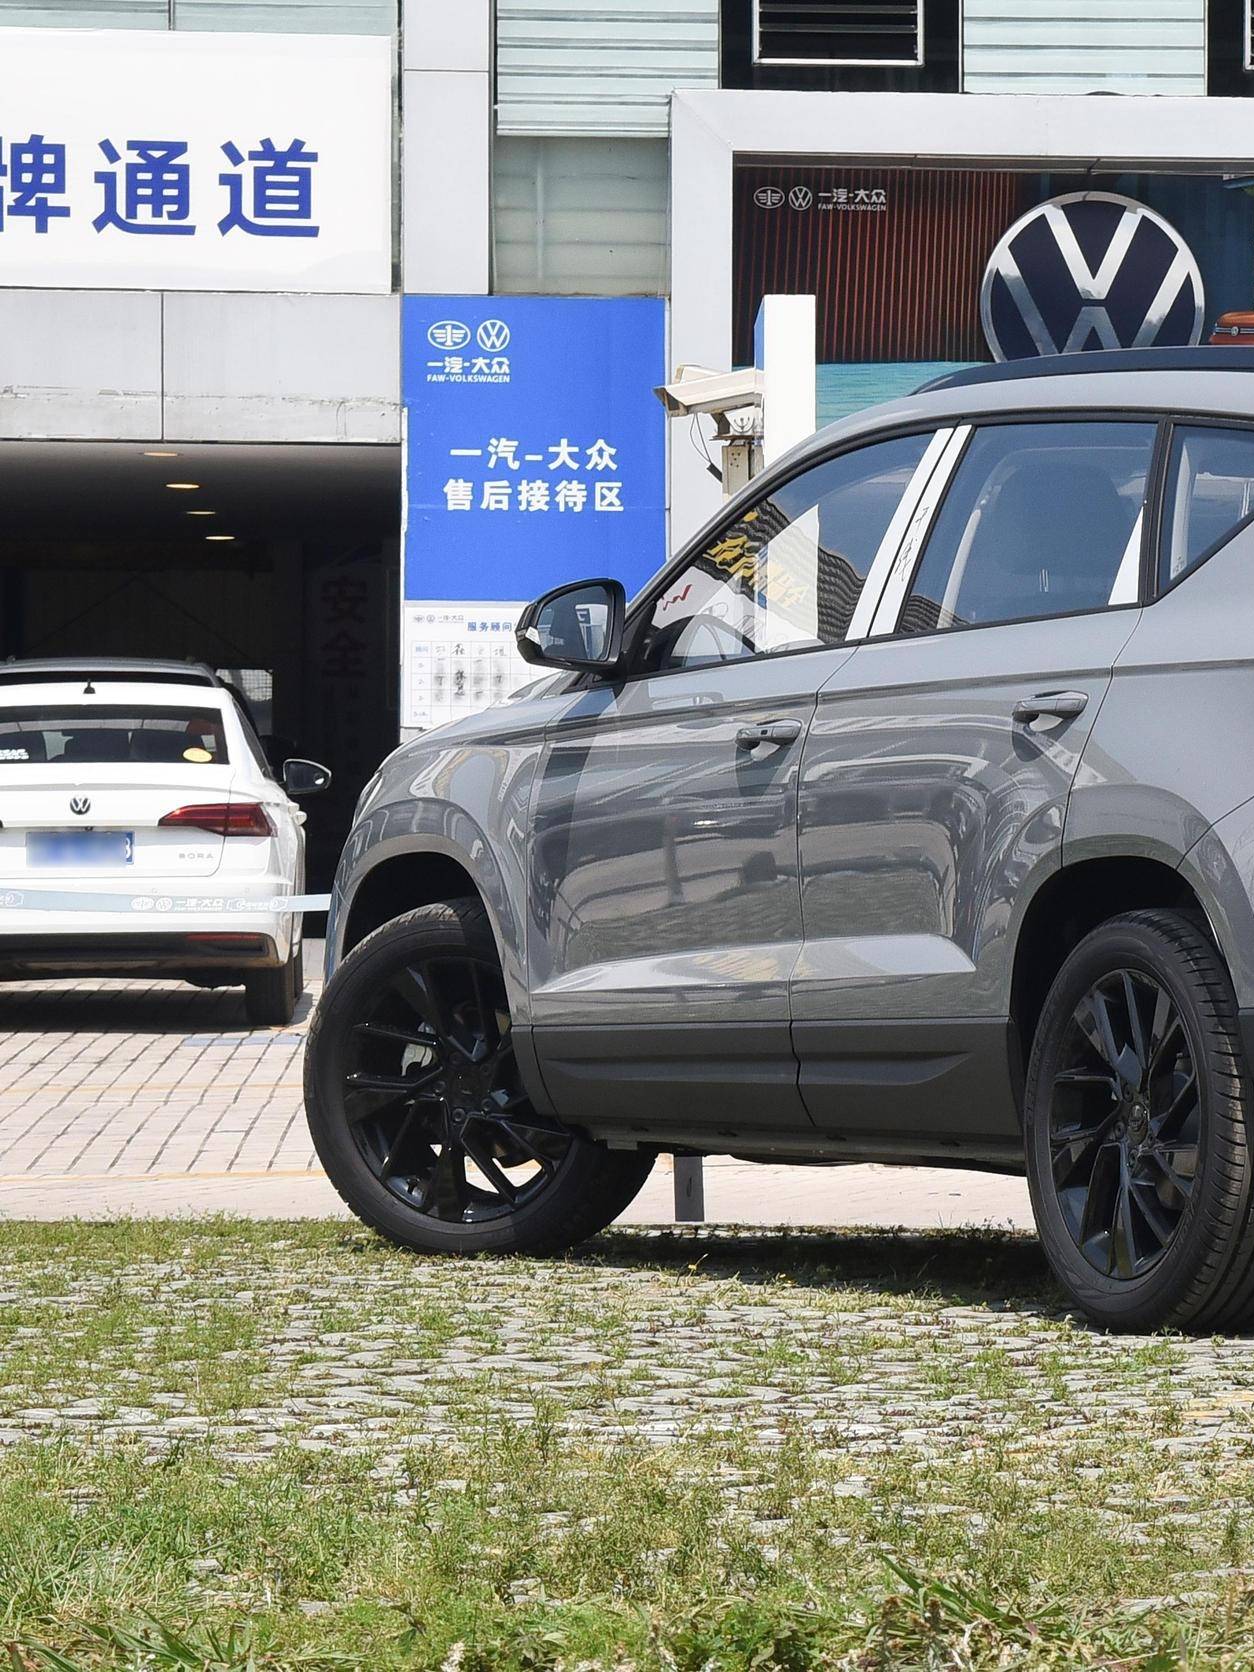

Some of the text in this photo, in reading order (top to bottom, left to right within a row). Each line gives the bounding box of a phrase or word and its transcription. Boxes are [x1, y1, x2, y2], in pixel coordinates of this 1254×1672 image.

[0, 134, 320, 237] 牌通道
[818, 203, 886, 211] FAW-VOLKSWAGEN
[427, 357, 510, 374] 一汽-大众
[427, 374, 510, 383] FAW-VOLKSWAGEN
[450, 437, 618, 471] 一汽-大众
[443, 478, 624, 512] 售后接待区
[467, 621, 517, 632] 服务顾问
